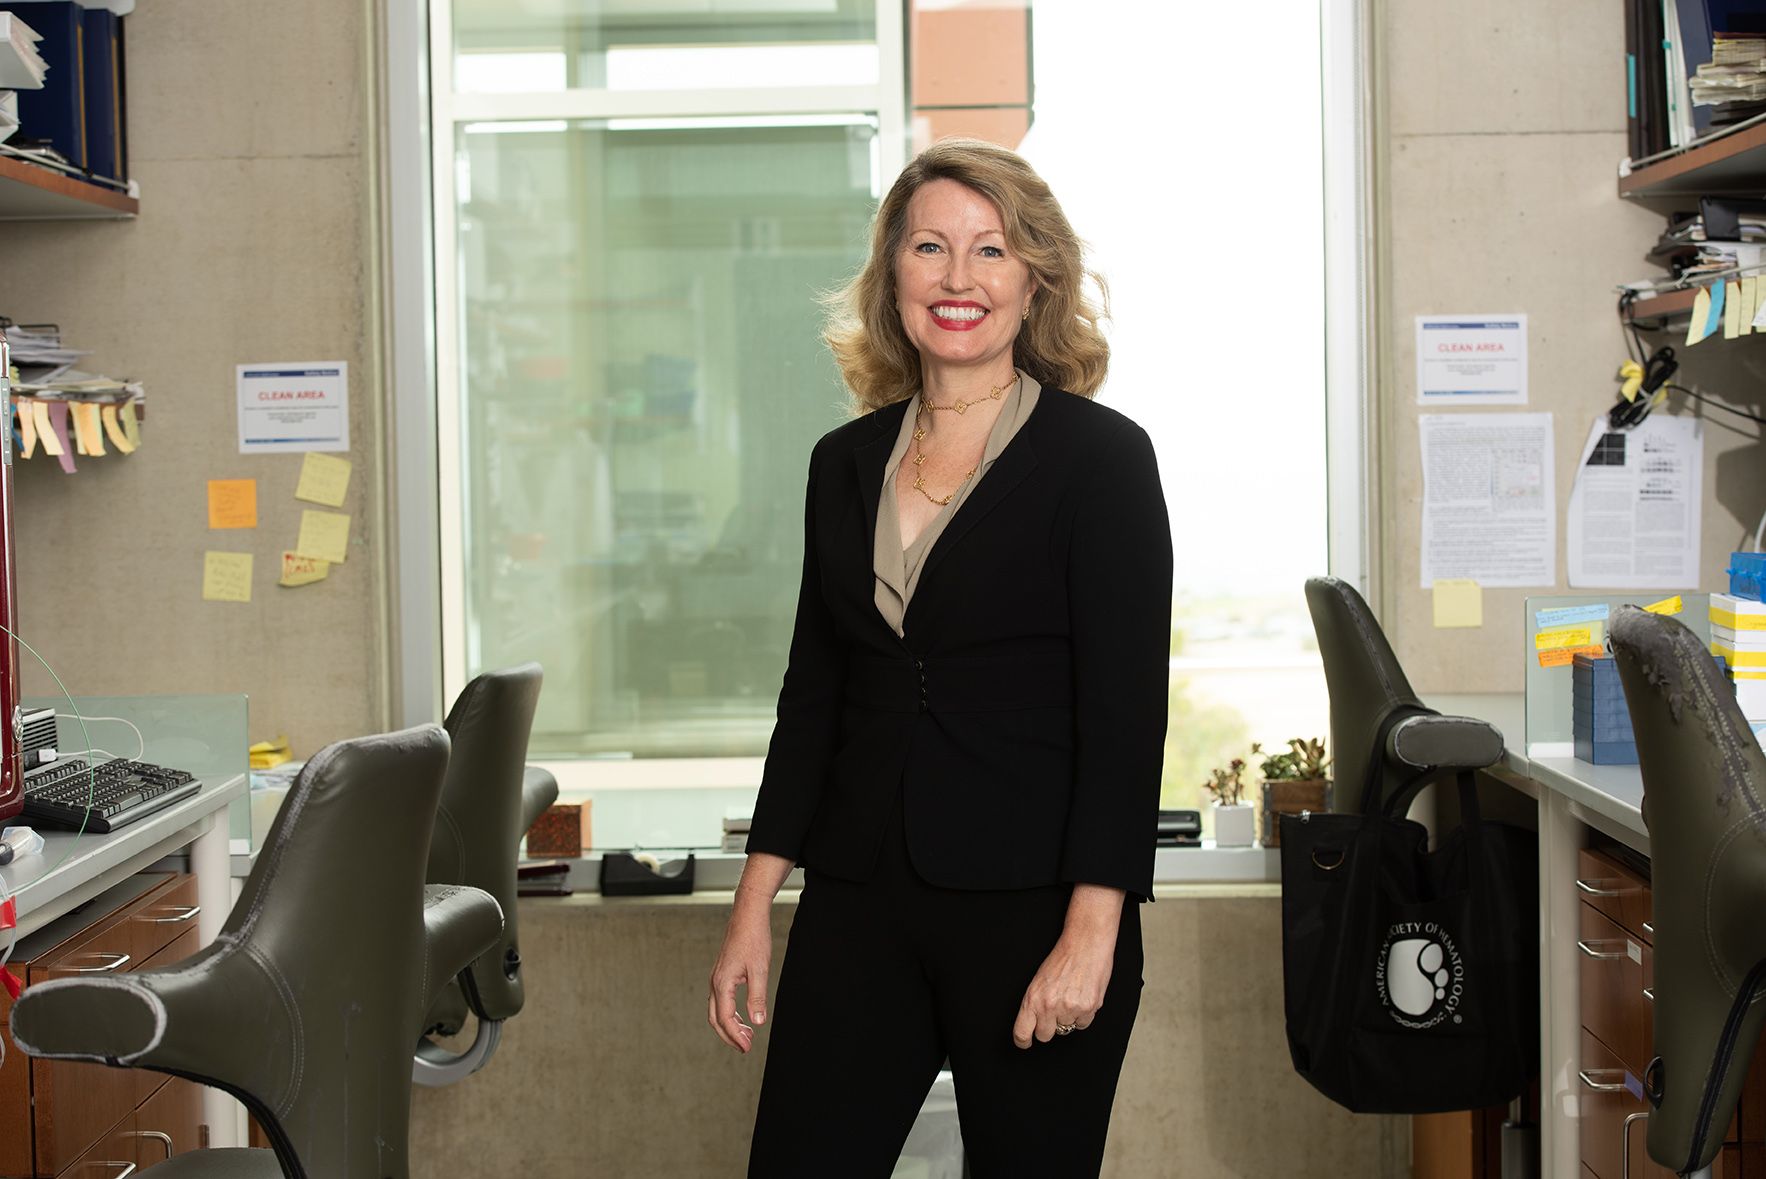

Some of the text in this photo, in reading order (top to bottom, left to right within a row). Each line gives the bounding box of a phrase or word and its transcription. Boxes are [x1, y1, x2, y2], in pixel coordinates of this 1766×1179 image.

[1437, 342, 1505, 352] CLEAN AREA
[258, 390, 325, 401] CLEAN AREA
[1376, 940, 1390, 1006] AMERICAN
[1438, 928, 1464, 1014] HEMATOLOGY
